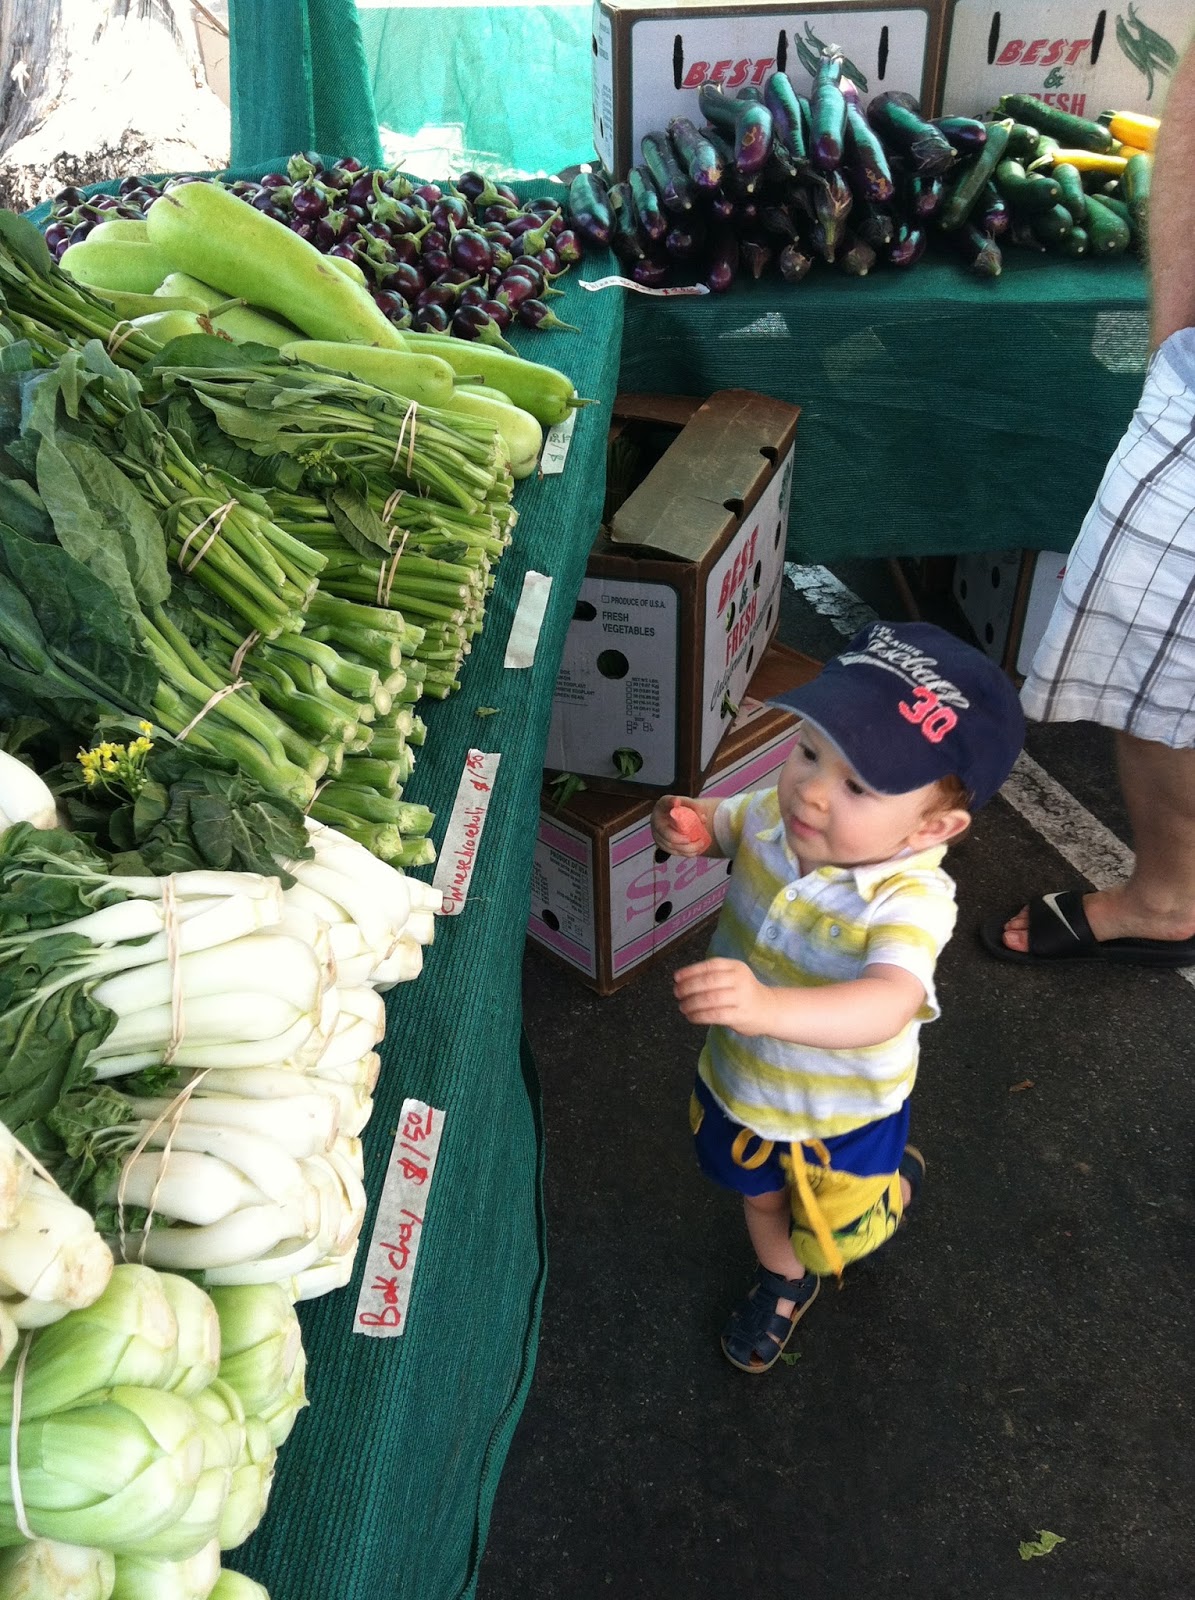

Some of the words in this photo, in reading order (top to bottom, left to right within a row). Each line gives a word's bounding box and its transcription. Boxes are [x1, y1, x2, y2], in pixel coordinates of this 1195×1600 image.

[995, 39, 1092, 66] BEST
[681, 58, 776, 89] BEST
[1043, 67, 1065, 89] &
[717, 524, 759, 619] BEST
[611, 596, 639, 607] PRODUCE
[641, 599, 648, 607] OF
[602, 611, 629, 622] FRESH
[602, 623, 655, 637] VEGETABLES
[726, 592, 758, 667] FRESH
[898, 685, 958, 743] 30
